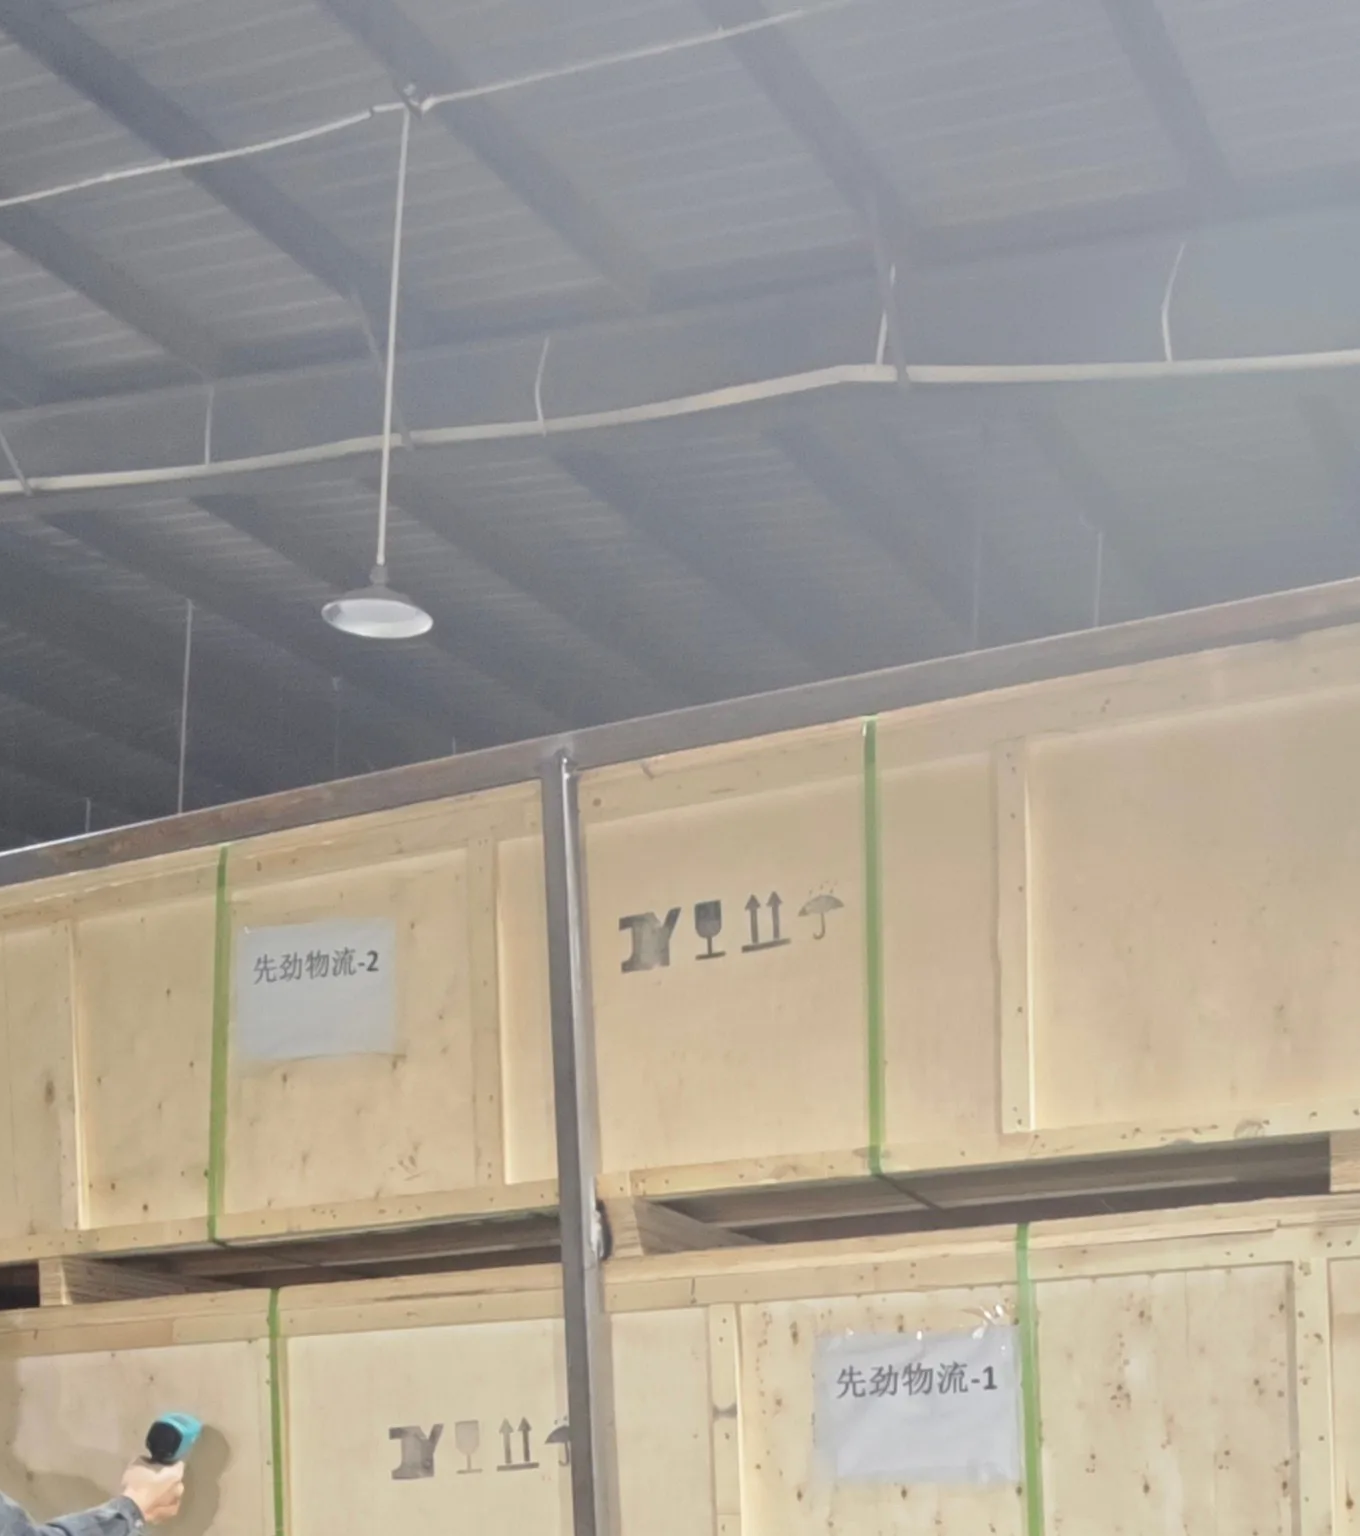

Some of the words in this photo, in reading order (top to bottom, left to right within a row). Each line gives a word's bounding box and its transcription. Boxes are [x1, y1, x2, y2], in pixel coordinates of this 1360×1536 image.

[254, 948, 379, 984] 先劲物流-2
[836, 1361, 998, 1399] 先劲物流-1
